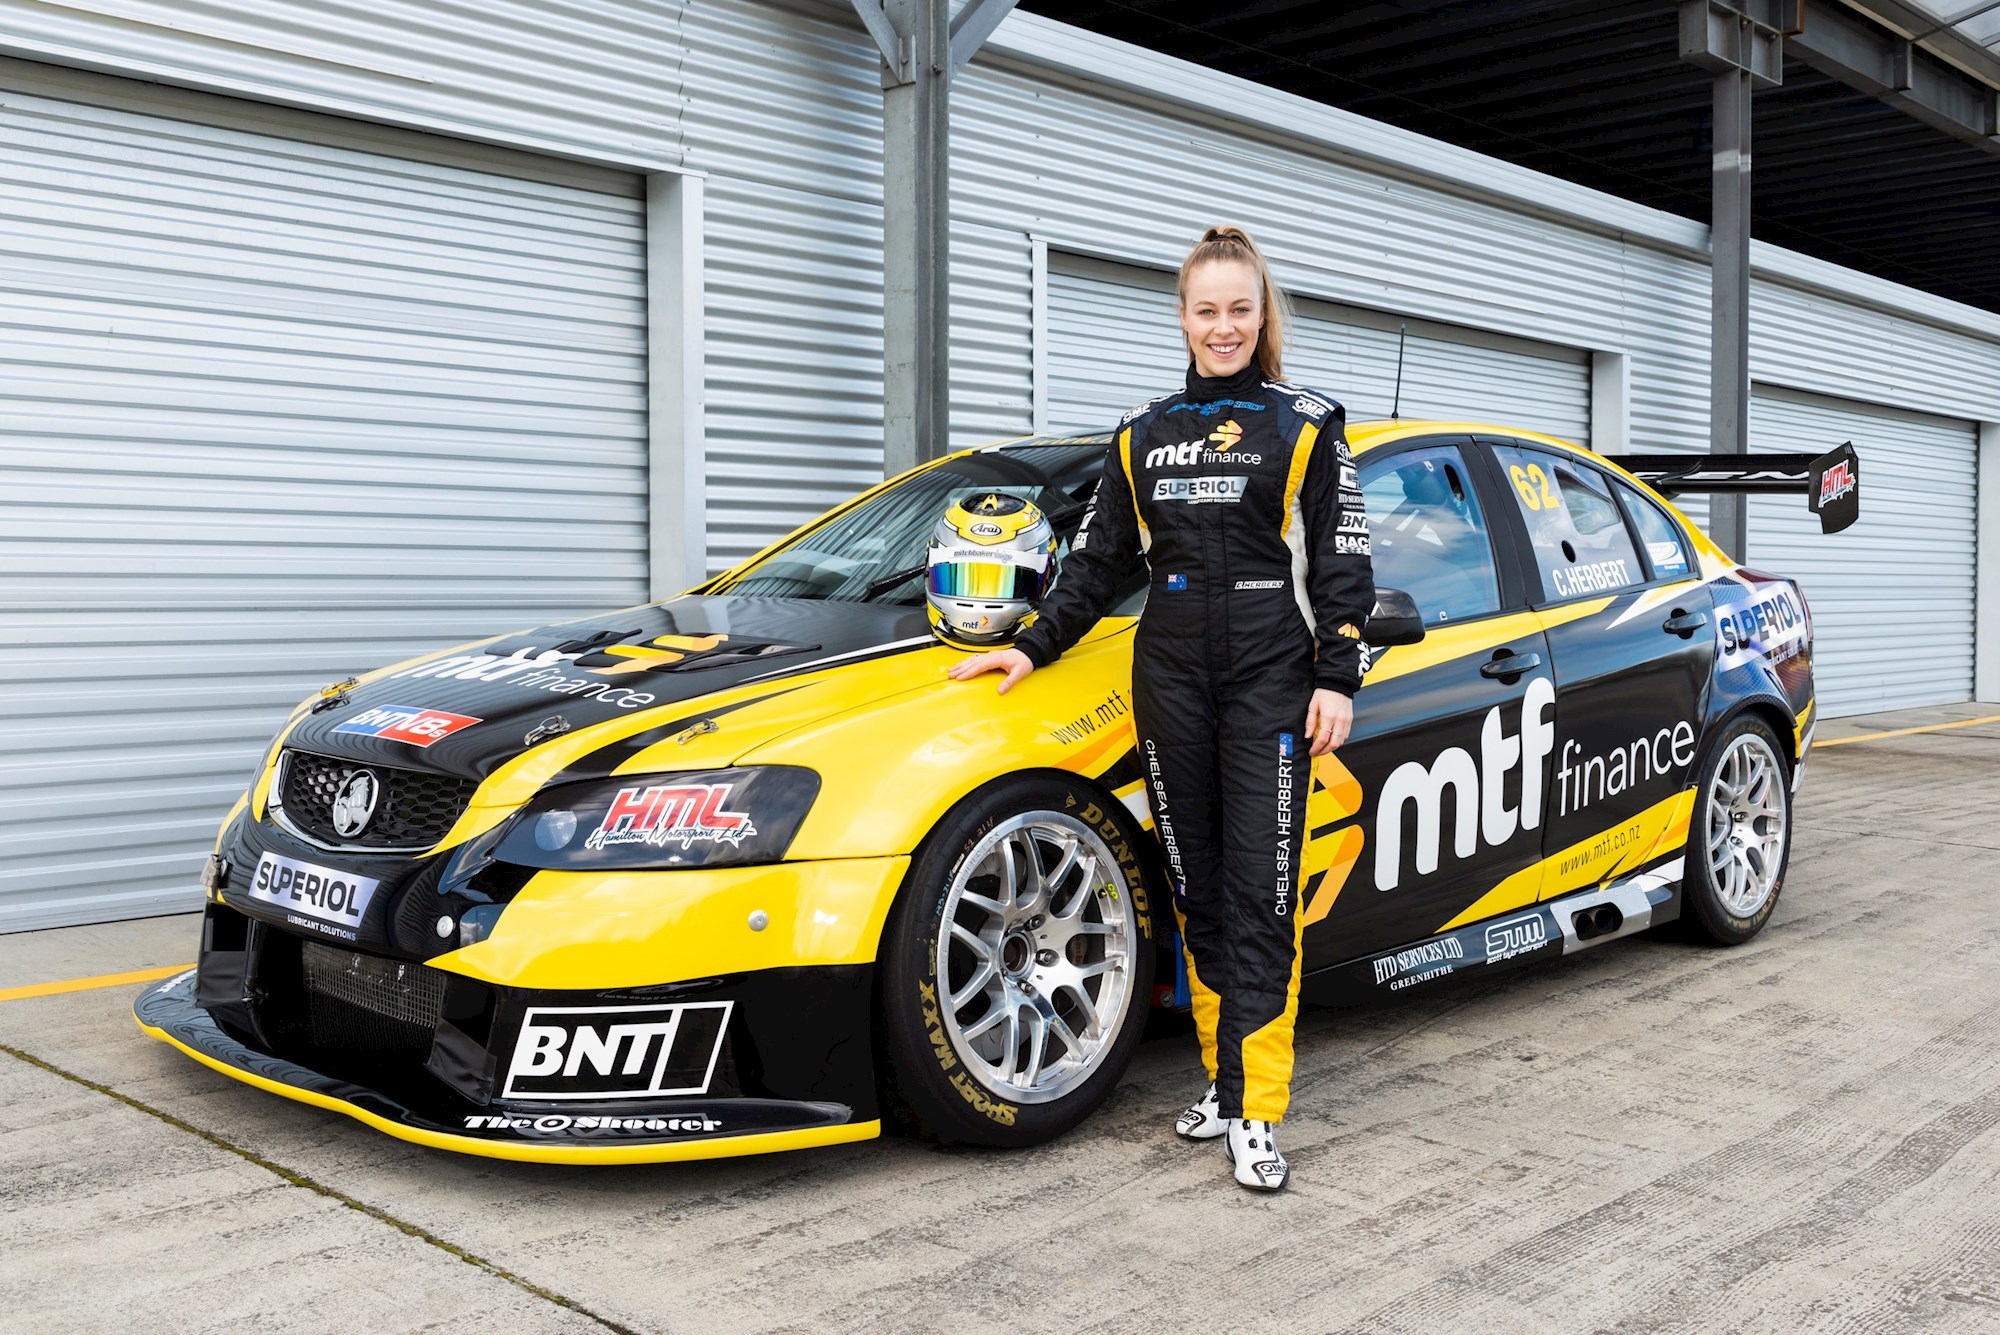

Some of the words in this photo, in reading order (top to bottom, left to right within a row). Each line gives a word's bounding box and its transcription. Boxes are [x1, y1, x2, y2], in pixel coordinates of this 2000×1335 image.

[1294, 398, 1326, 417] OMP
[1145, 438, 1206, 469] mtf
[1203, 449, 1262, 465] finance
[1158, 480, 1241, 496] SUPERIOL
[1509, 463, 1560, 511] 62
[974, 523, 999, 534] Arai
[1552, 559, 1631, 597] C.HERBERT
[962, 621, 979, 630] mtf
[1720, 591, 1802, 657] SUPERIOL
[390, 646, 584, 682] mtf
[506, 667, 656, 708] finance
[345, 709, 411, 728] BNT
[601, 783, 750, 833] HML
[1277, 756, 1293, 836] HERBERT
[1373, 676, 1556, 892] mtf
[1556, 719, 1697, 818] finance
[586, 822, 646, 848] Hamilton
[648, 822, 716, 847] Motorsport
[1145, 739, 1168, 813] CHELSEA
[1160, 813, 1187, 885] HERBERT
[1078, 801, 1153, 940] DUNLOP
[1560, 824, 1641, 876] www.mtf.co.nz
[256, 861, 360, 917] SUPERIOL
[1275, 838, 1291, 916] CHELSEA
[287, 914, 320, 932] LUBRICANT
[319, 924, 357, 942] SOLUTIONS
[1373, 955, 1398, 985] HTD
[1397, 939, 1444, 972] SERVICES
[1441, 937, 1464, 959] LTD
[1390, 964, 1454, 991] GREENHITHE
[918, 979, 958, 1071] MAXX
[463, 1115, 533, 1130] The
[572, 1114, 723, 1132] Shooter
[948, 1071, 1019, 1127] SPORT
